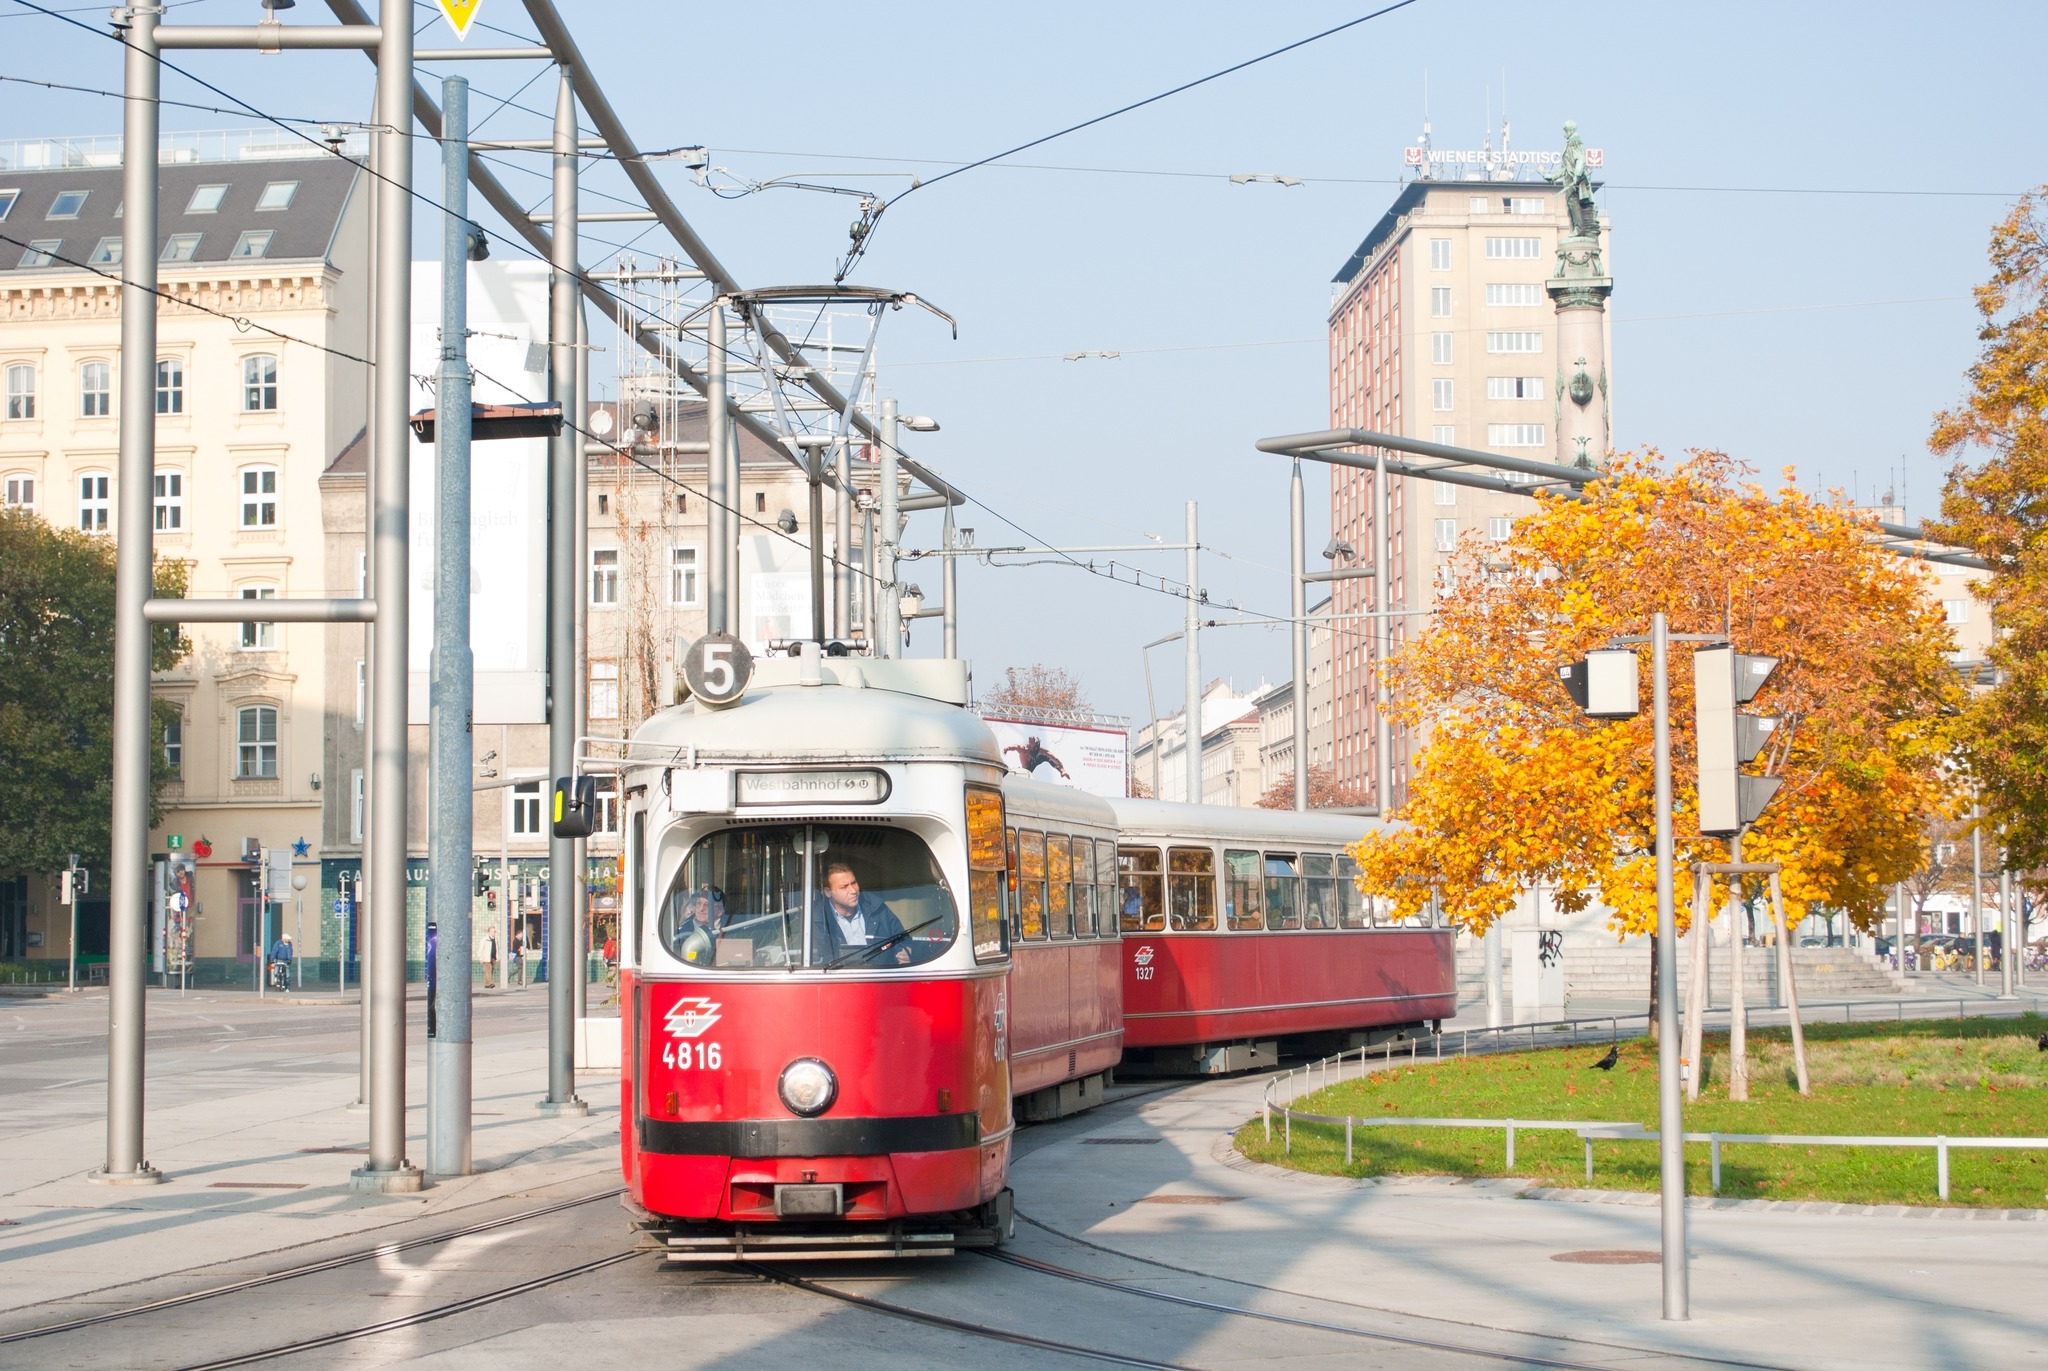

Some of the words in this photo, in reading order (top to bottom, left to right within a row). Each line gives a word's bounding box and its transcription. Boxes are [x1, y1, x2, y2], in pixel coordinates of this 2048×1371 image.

[1427, 150, 1487, 163] WIENER
[1492, 150, 1562, 164] STÄDTISC
[703, 643, 734, 696] 5
[745, 778, 841, 790] Westbahnhof
[1135, 966, 1154, 980] 1327
[662, 1042, 722, 1070] 4816
